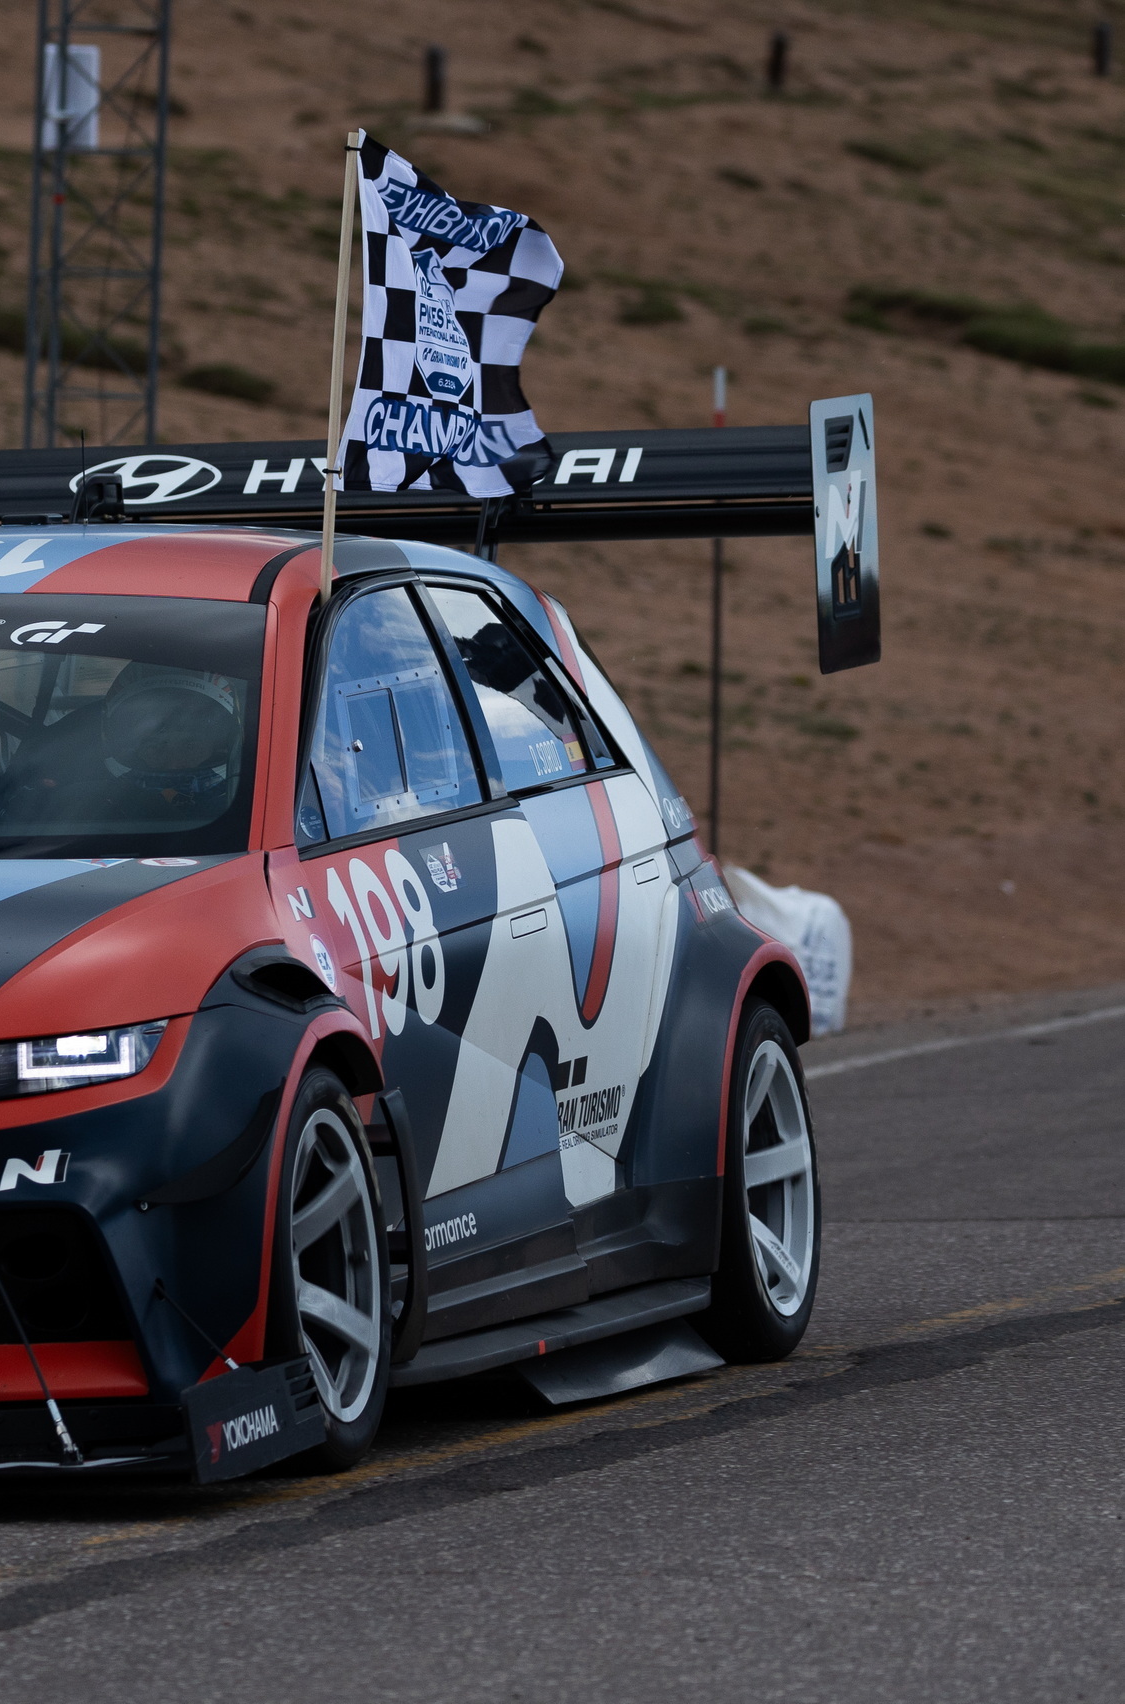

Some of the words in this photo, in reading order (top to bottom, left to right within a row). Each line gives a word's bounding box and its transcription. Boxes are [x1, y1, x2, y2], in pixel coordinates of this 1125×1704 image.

[326, 849, 445, 1040] 198
[557, 1097, 579, 1134] RAN
[222, 1404, 280, 1452] YOKOHAMA
